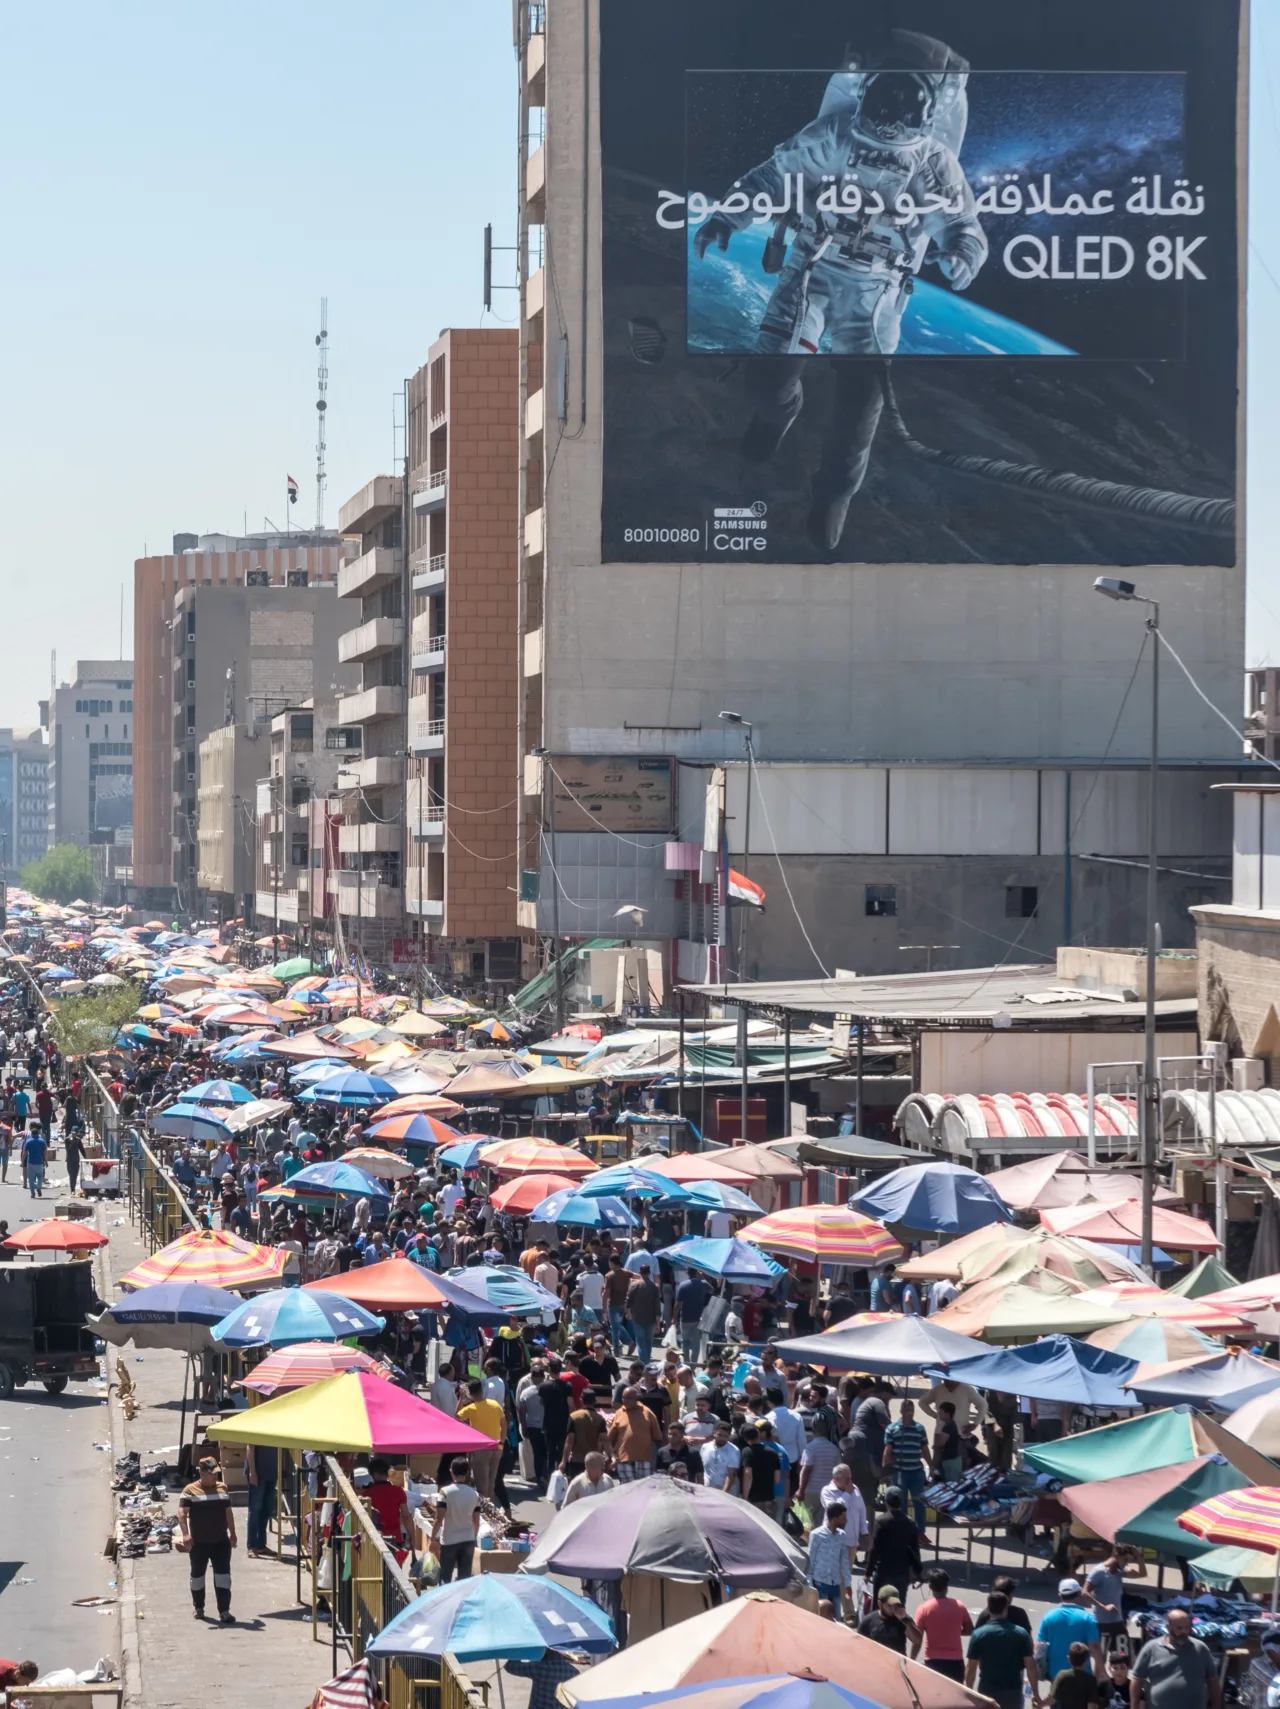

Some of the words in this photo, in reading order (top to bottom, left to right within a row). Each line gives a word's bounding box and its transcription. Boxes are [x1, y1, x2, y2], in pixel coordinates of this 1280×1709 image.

[655, 172, 804, 230] الوضوح
[815, 173, 885, 214] دقة
[894, 183, 964, 225] نحو
[975, 173, 1115, 216] عملاقة
[1125, 174, 1205, 216] نقلة
[1003, 234, 1135, 280] QLED
[1146, 235, 1208, 280] 8K
[624, 528, 700, 543] 80010080
[713, 520, 768, 530] SAMSUNG
[713, 534, 768, 551] Care
